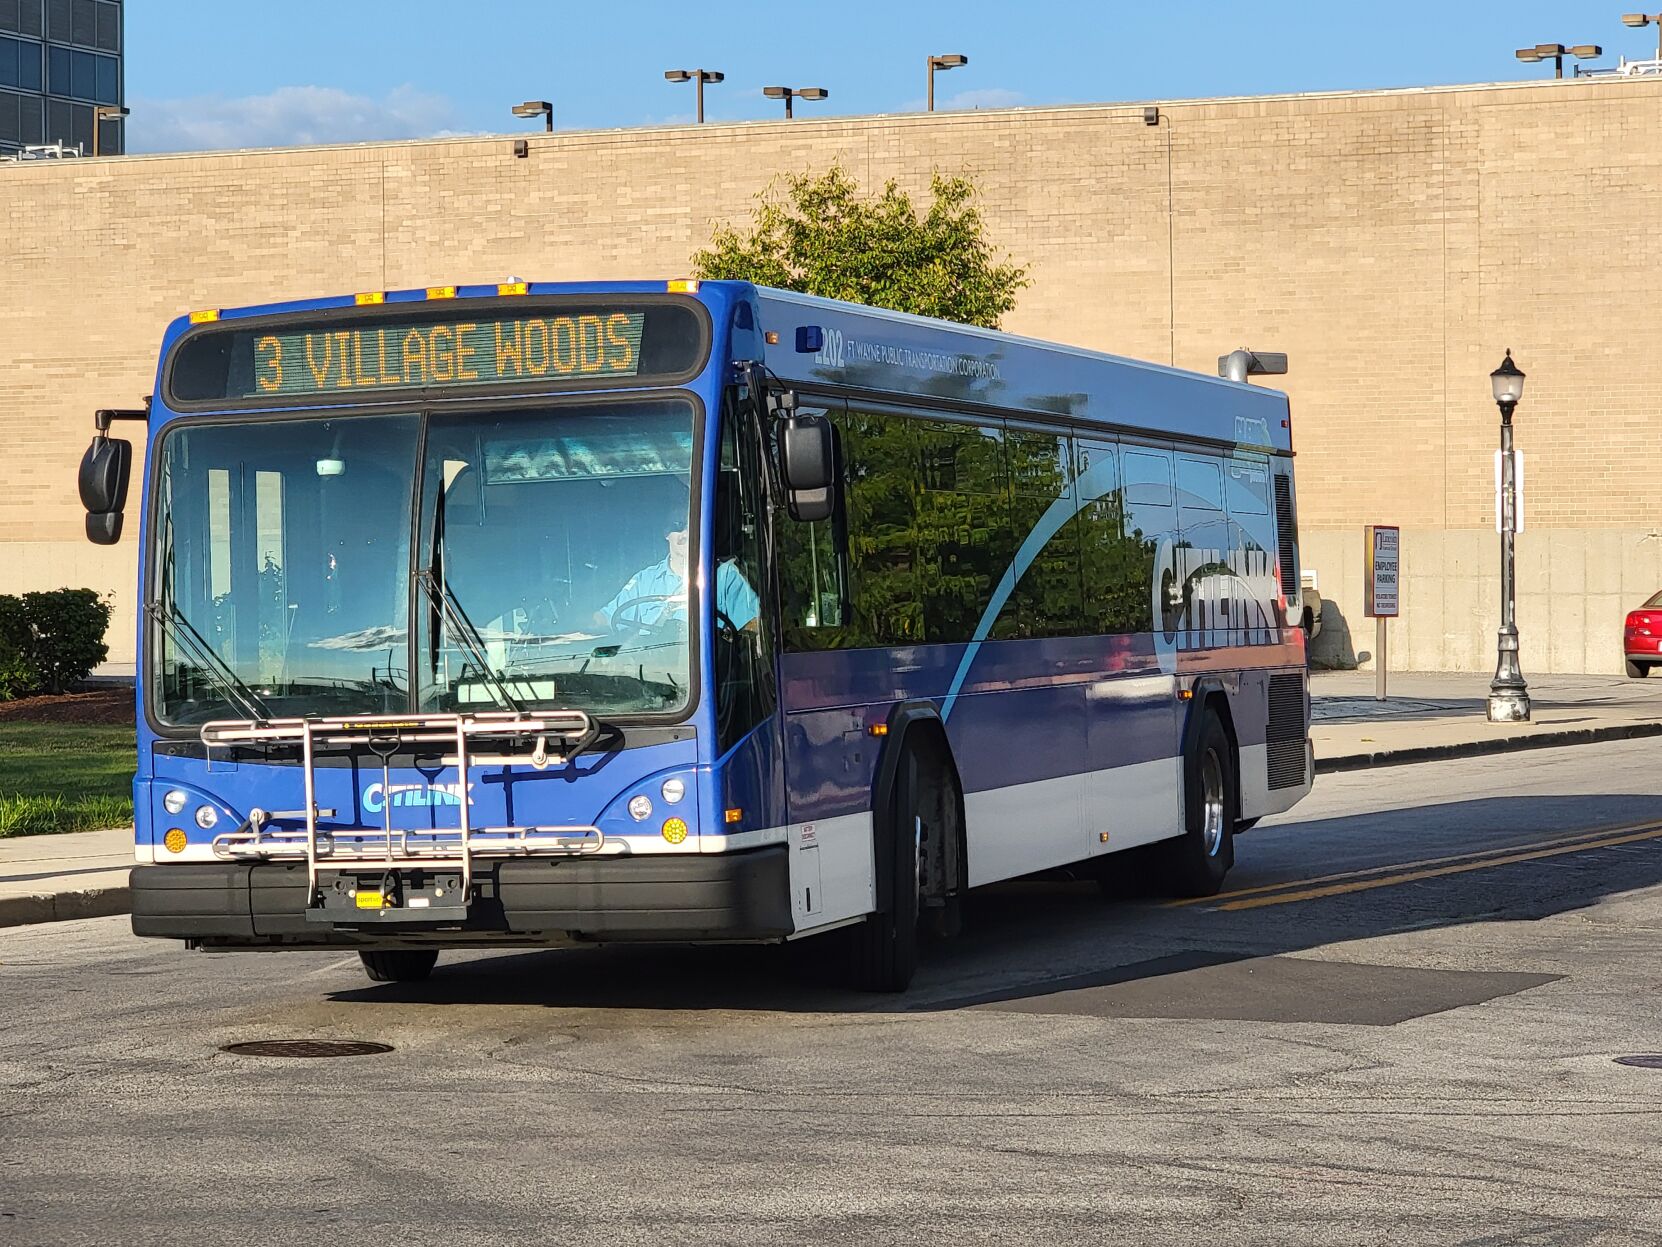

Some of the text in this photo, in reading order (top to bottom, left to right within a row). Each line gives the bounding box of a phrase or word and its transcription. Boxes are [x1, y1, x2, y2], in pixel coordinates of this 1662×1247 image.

[258, 313, 633, 391] 3 VILLAGE WOODS
[814, 328, 844, 368] 202
[847, 340, 1000, 380] FT WAYNE PUBLIC TRANSPORTATION CORPORATION
[1375, 561, 1397, 572] EMPLOYEE
[1376, 574, 1396, 584] PARKING
[1152, 535, 1279, 673] CITILINK
